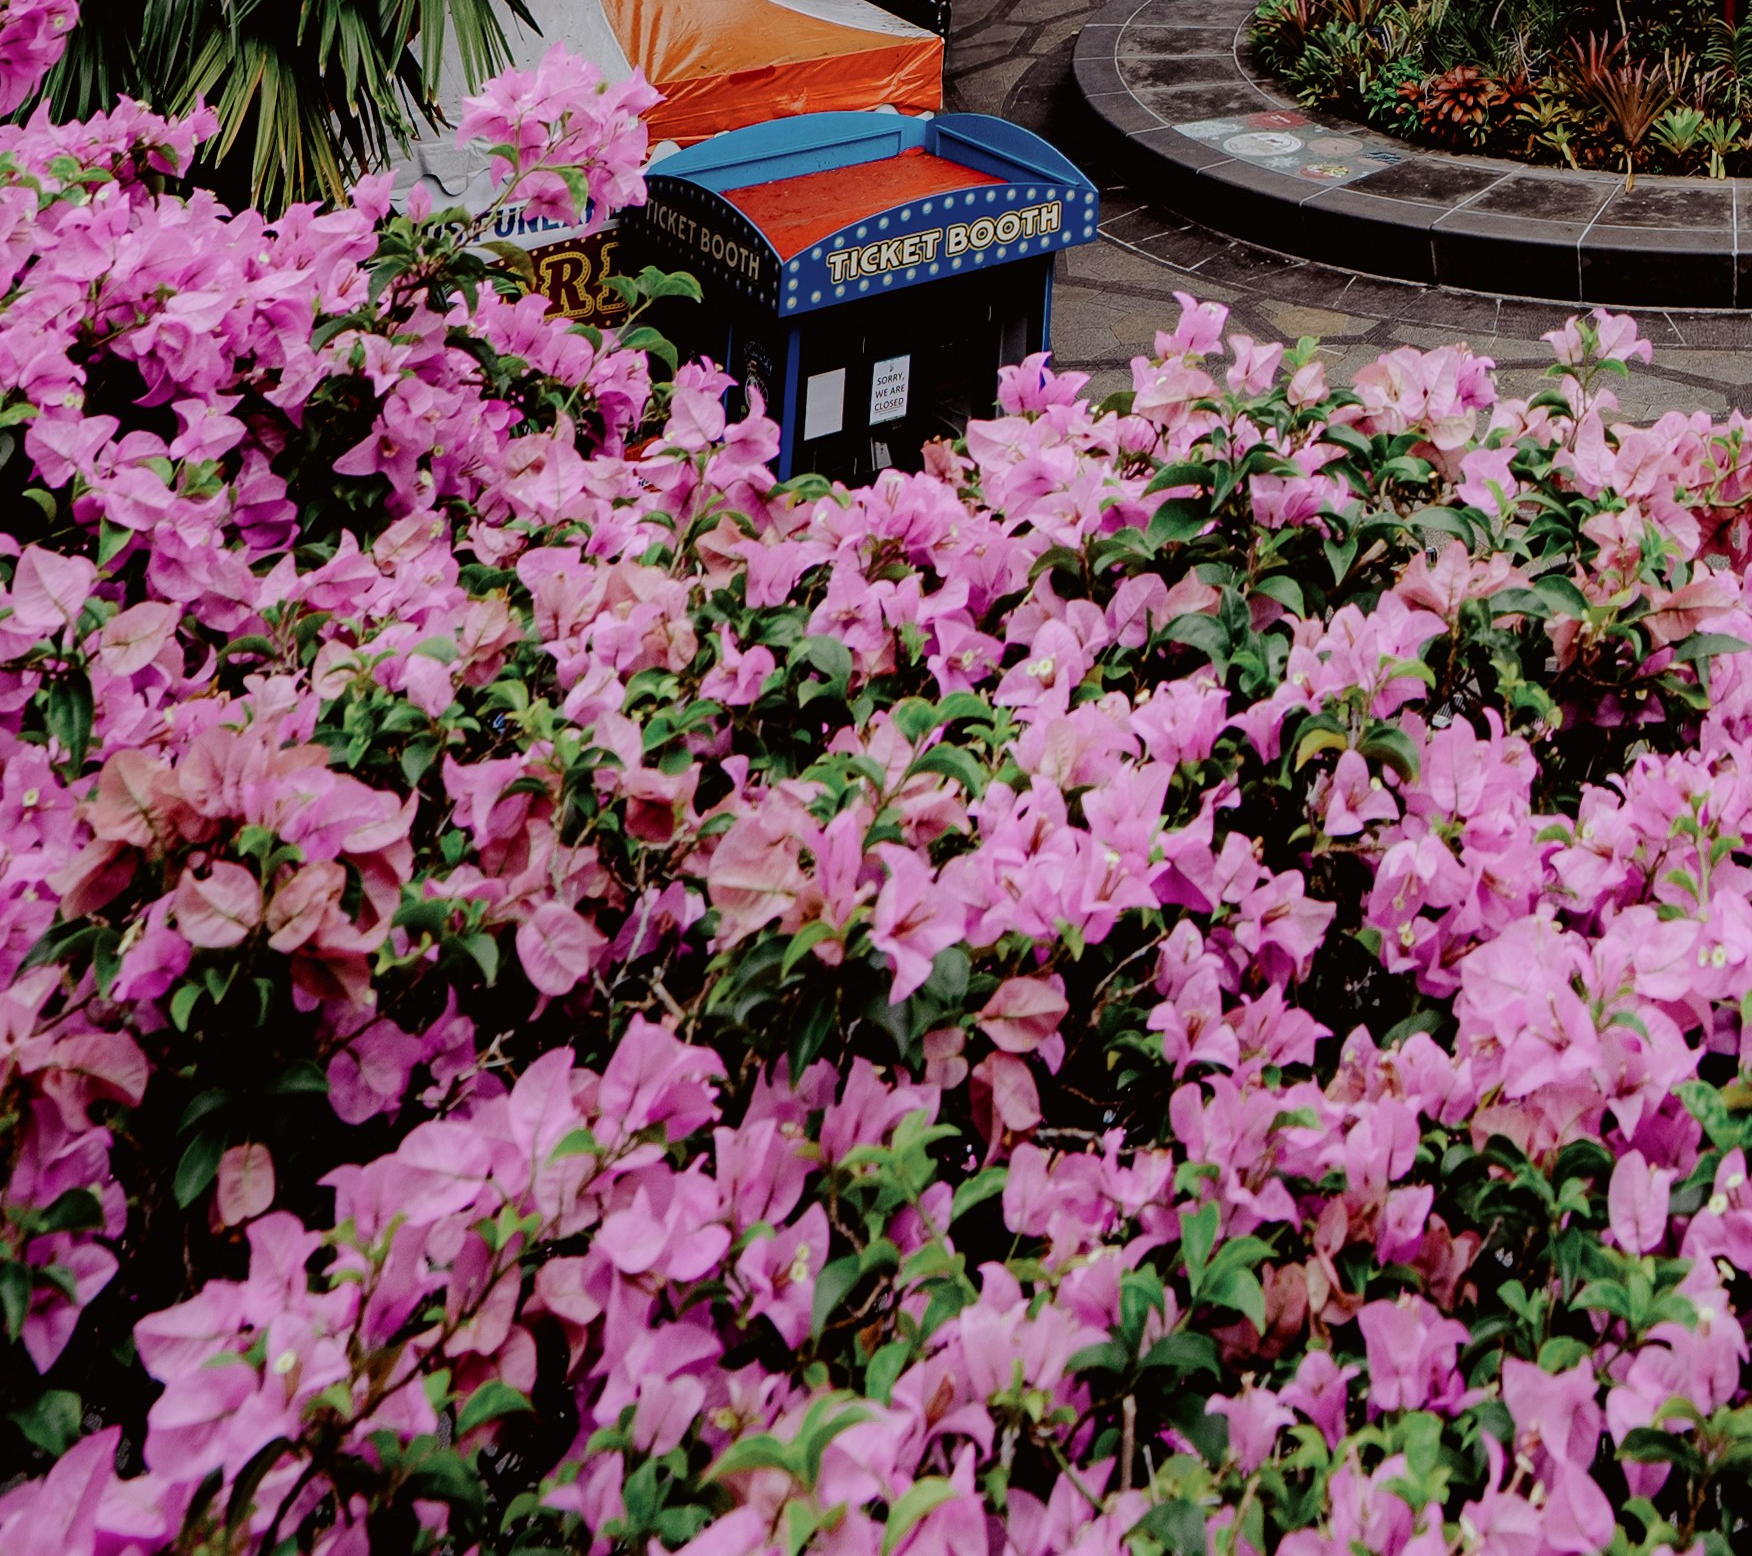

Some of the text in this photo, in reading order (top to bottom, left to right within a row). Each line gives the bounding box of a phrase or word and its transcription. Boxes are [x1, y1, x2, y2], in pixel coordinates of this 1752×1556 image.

[646, 197, 760, 281] TICKET BOOTH
[826, 200, 1062, 284] TICKET BOOTH
[877, 372, 905, 386] SORRY,
[875, 384, 905, 399] WE ARE
[874, 397, 904, 411] CLOSED
